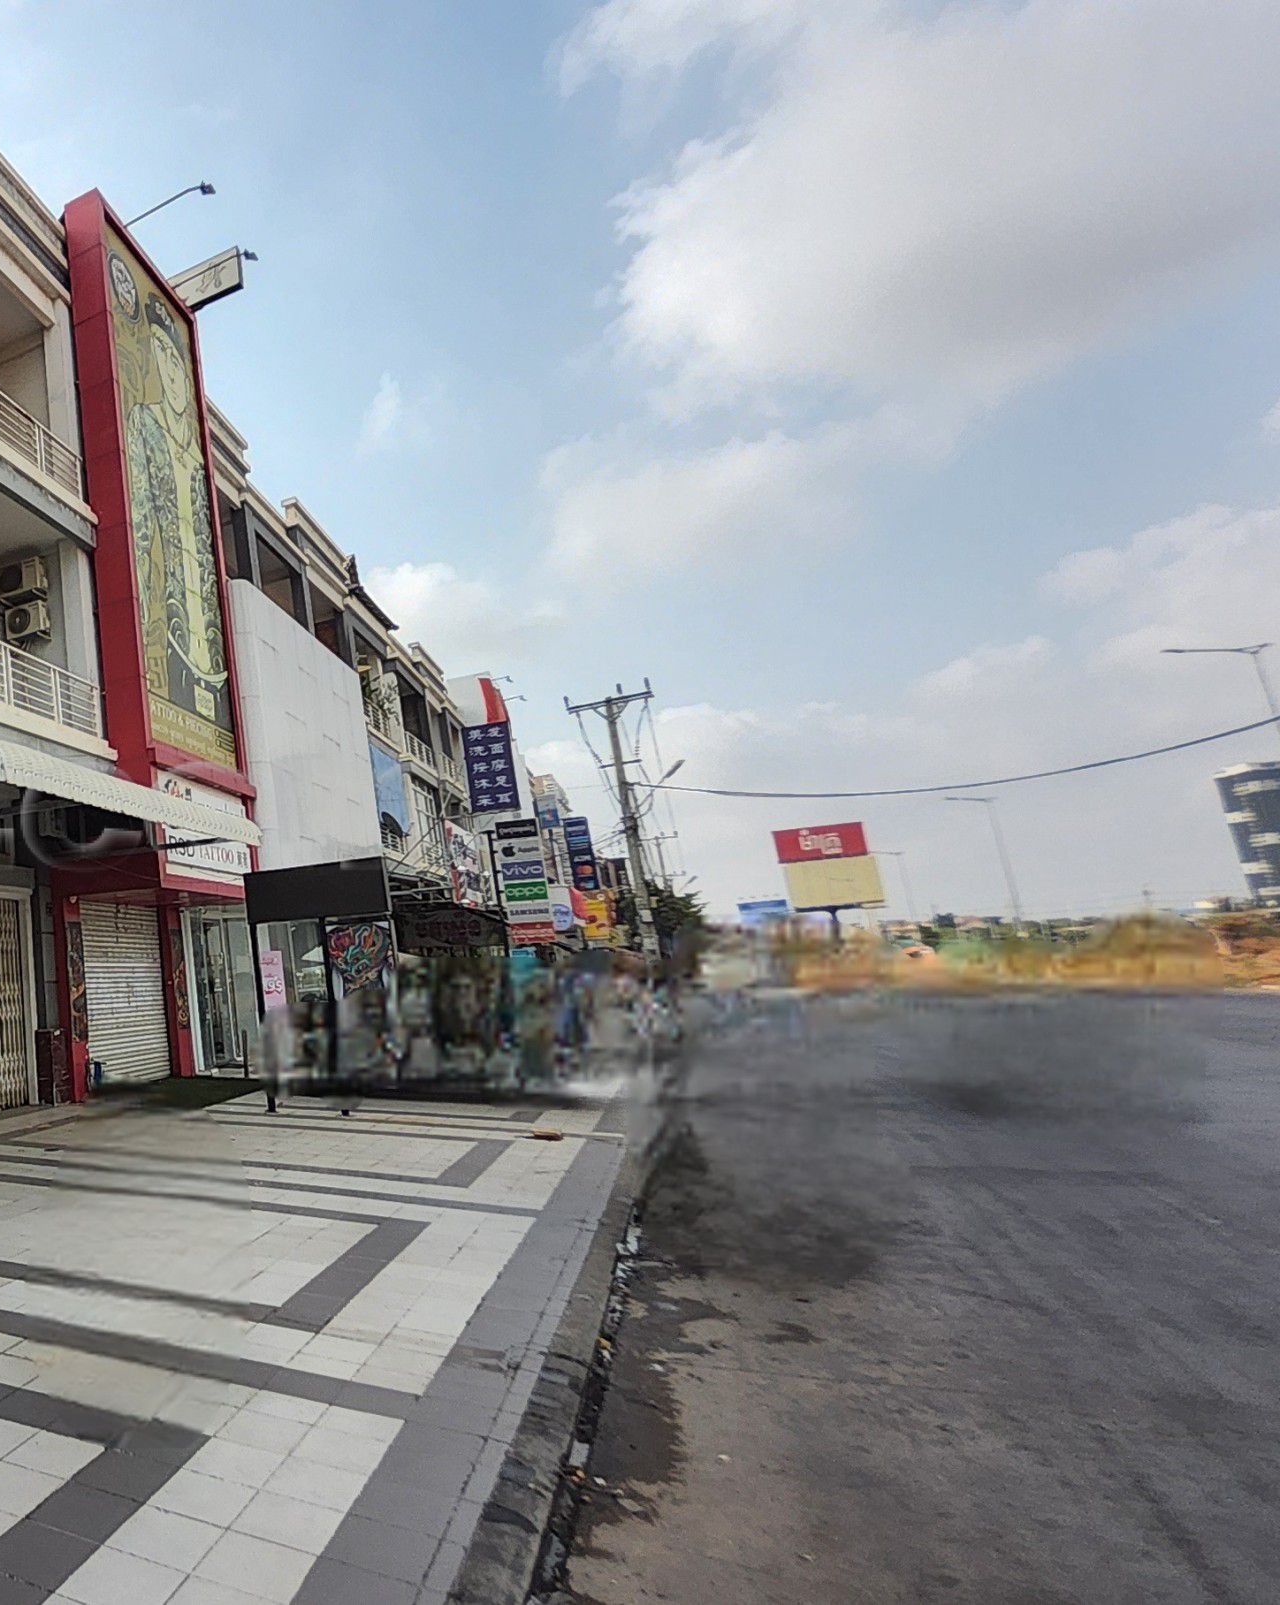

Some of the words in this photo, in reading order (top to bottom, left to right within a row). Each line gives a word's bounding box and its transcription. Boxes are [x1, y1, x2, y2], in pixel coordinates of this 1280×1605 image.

[472, 759, 509, 774] 按摩
[199, 844, 234, 865] TATTOO
[502, 864, 543, 876] vivo
[506, 886, 545, 897] oppo
